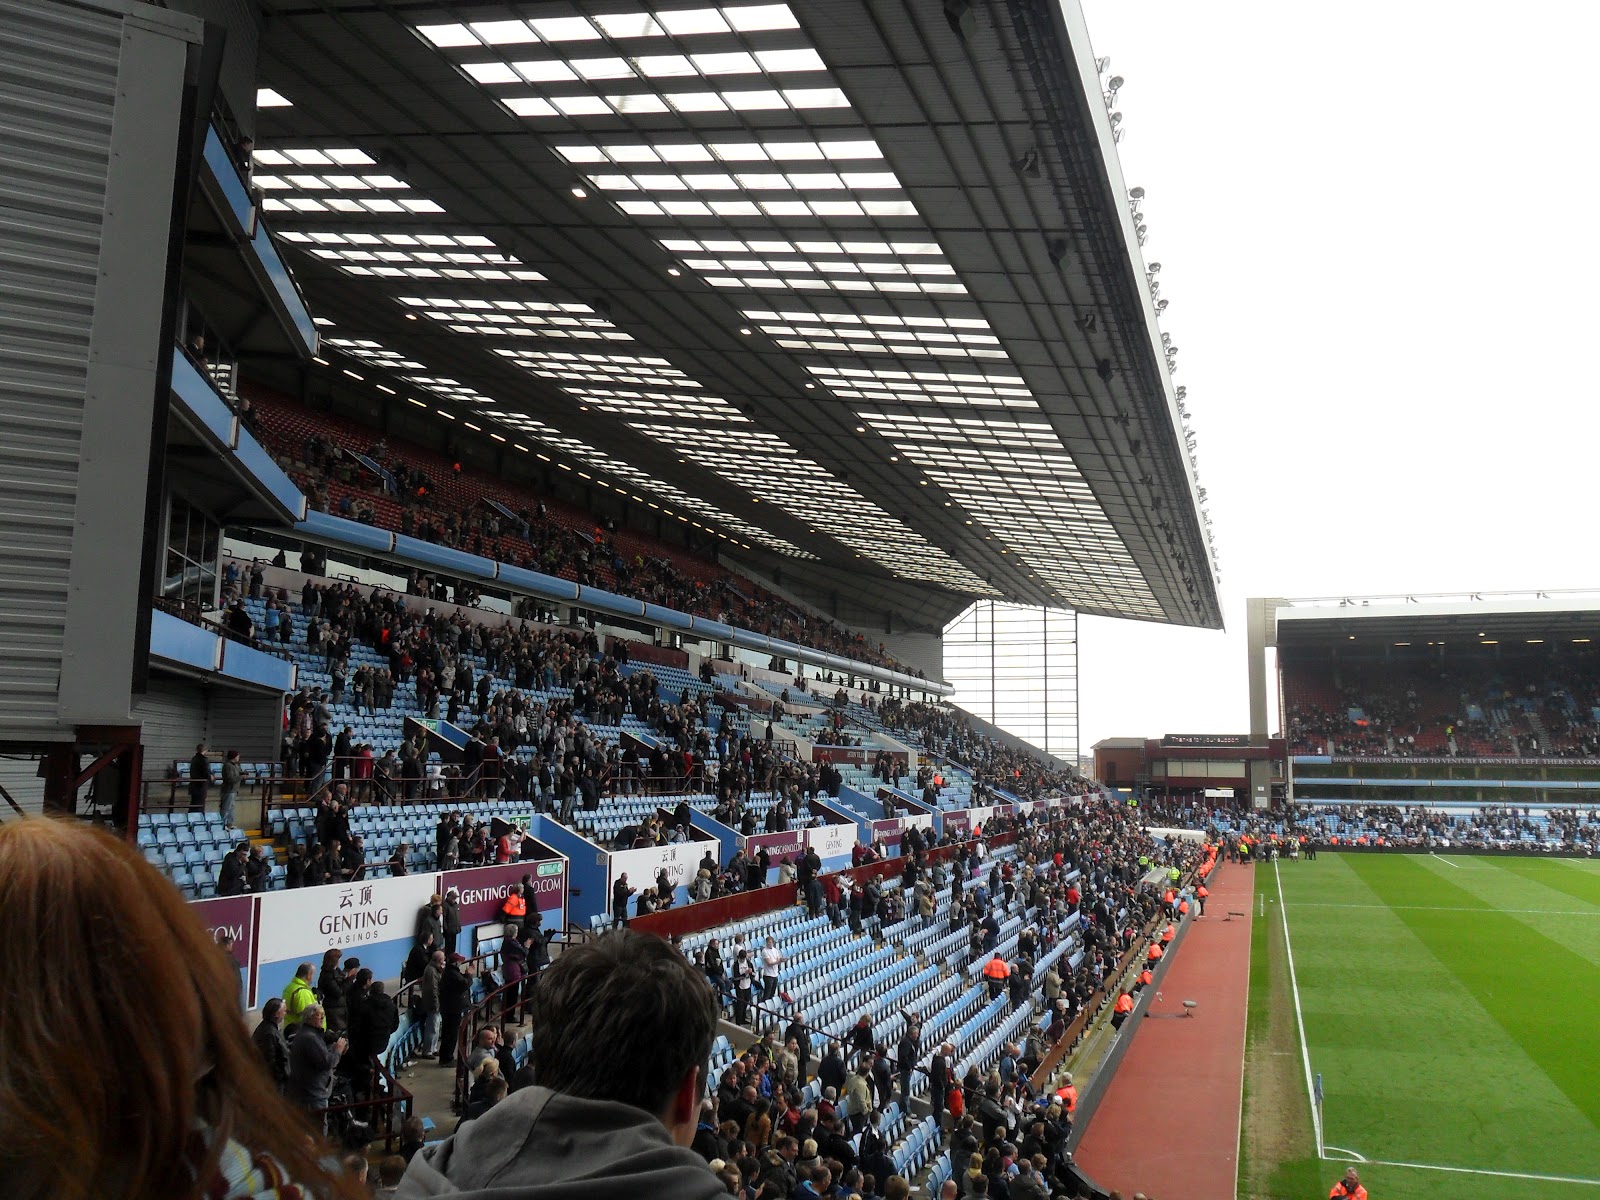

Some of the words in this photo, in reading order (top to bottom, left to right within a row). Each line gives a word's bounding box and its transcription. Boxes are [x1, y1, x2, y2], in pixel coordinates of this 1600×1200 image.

[654, 863, 684, 879] GTING
[339, 884, 373, 909] 云顶
[461, 878, 561, 905] GENTINGCO.COM
[319, 908, 388, 934] GENTING
[205, 924, 243, 944] OM
[328, 930, 378, 946] CASINOS
